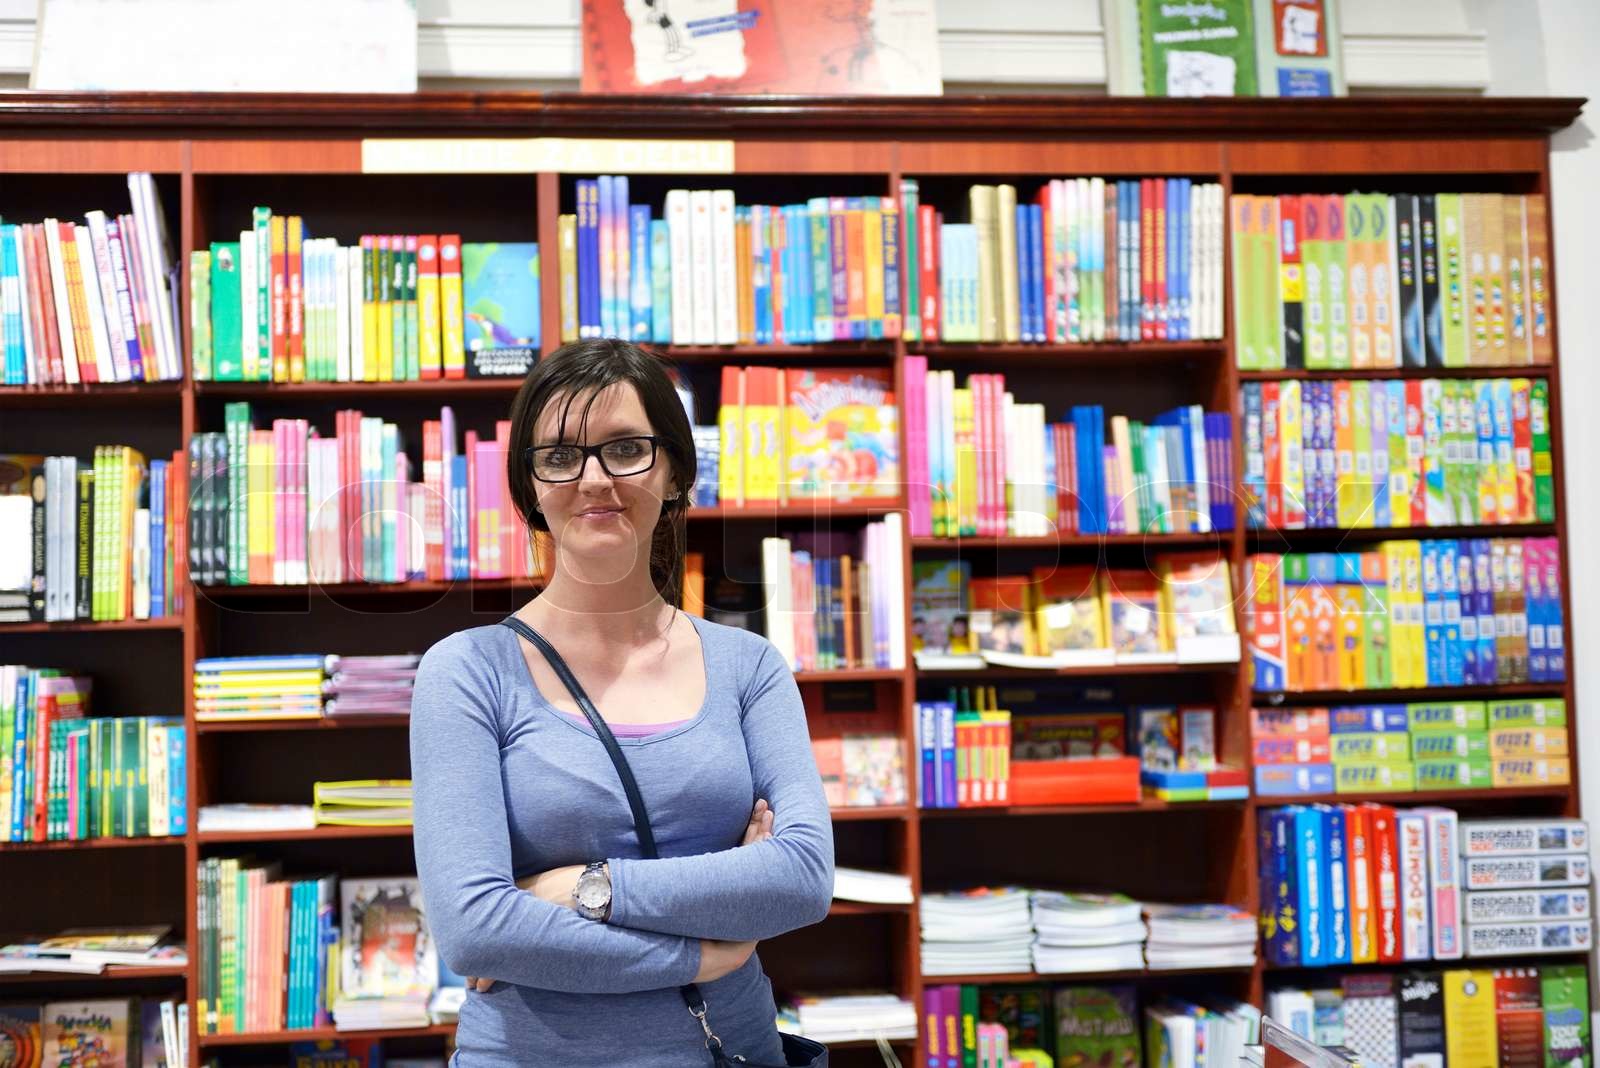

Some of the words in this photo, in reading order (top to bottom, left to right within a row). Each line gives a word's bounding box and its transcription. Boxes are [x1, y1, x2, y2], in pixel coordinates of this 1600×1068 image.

[1471, 829, 1534, 841] BEOGRAD
[1472, 861, 1535, 872] BEOGRAD
[1472, 895, 1535, 906] BEOGRAD
[1473, 928, 1537, 939] BEOGRAD
